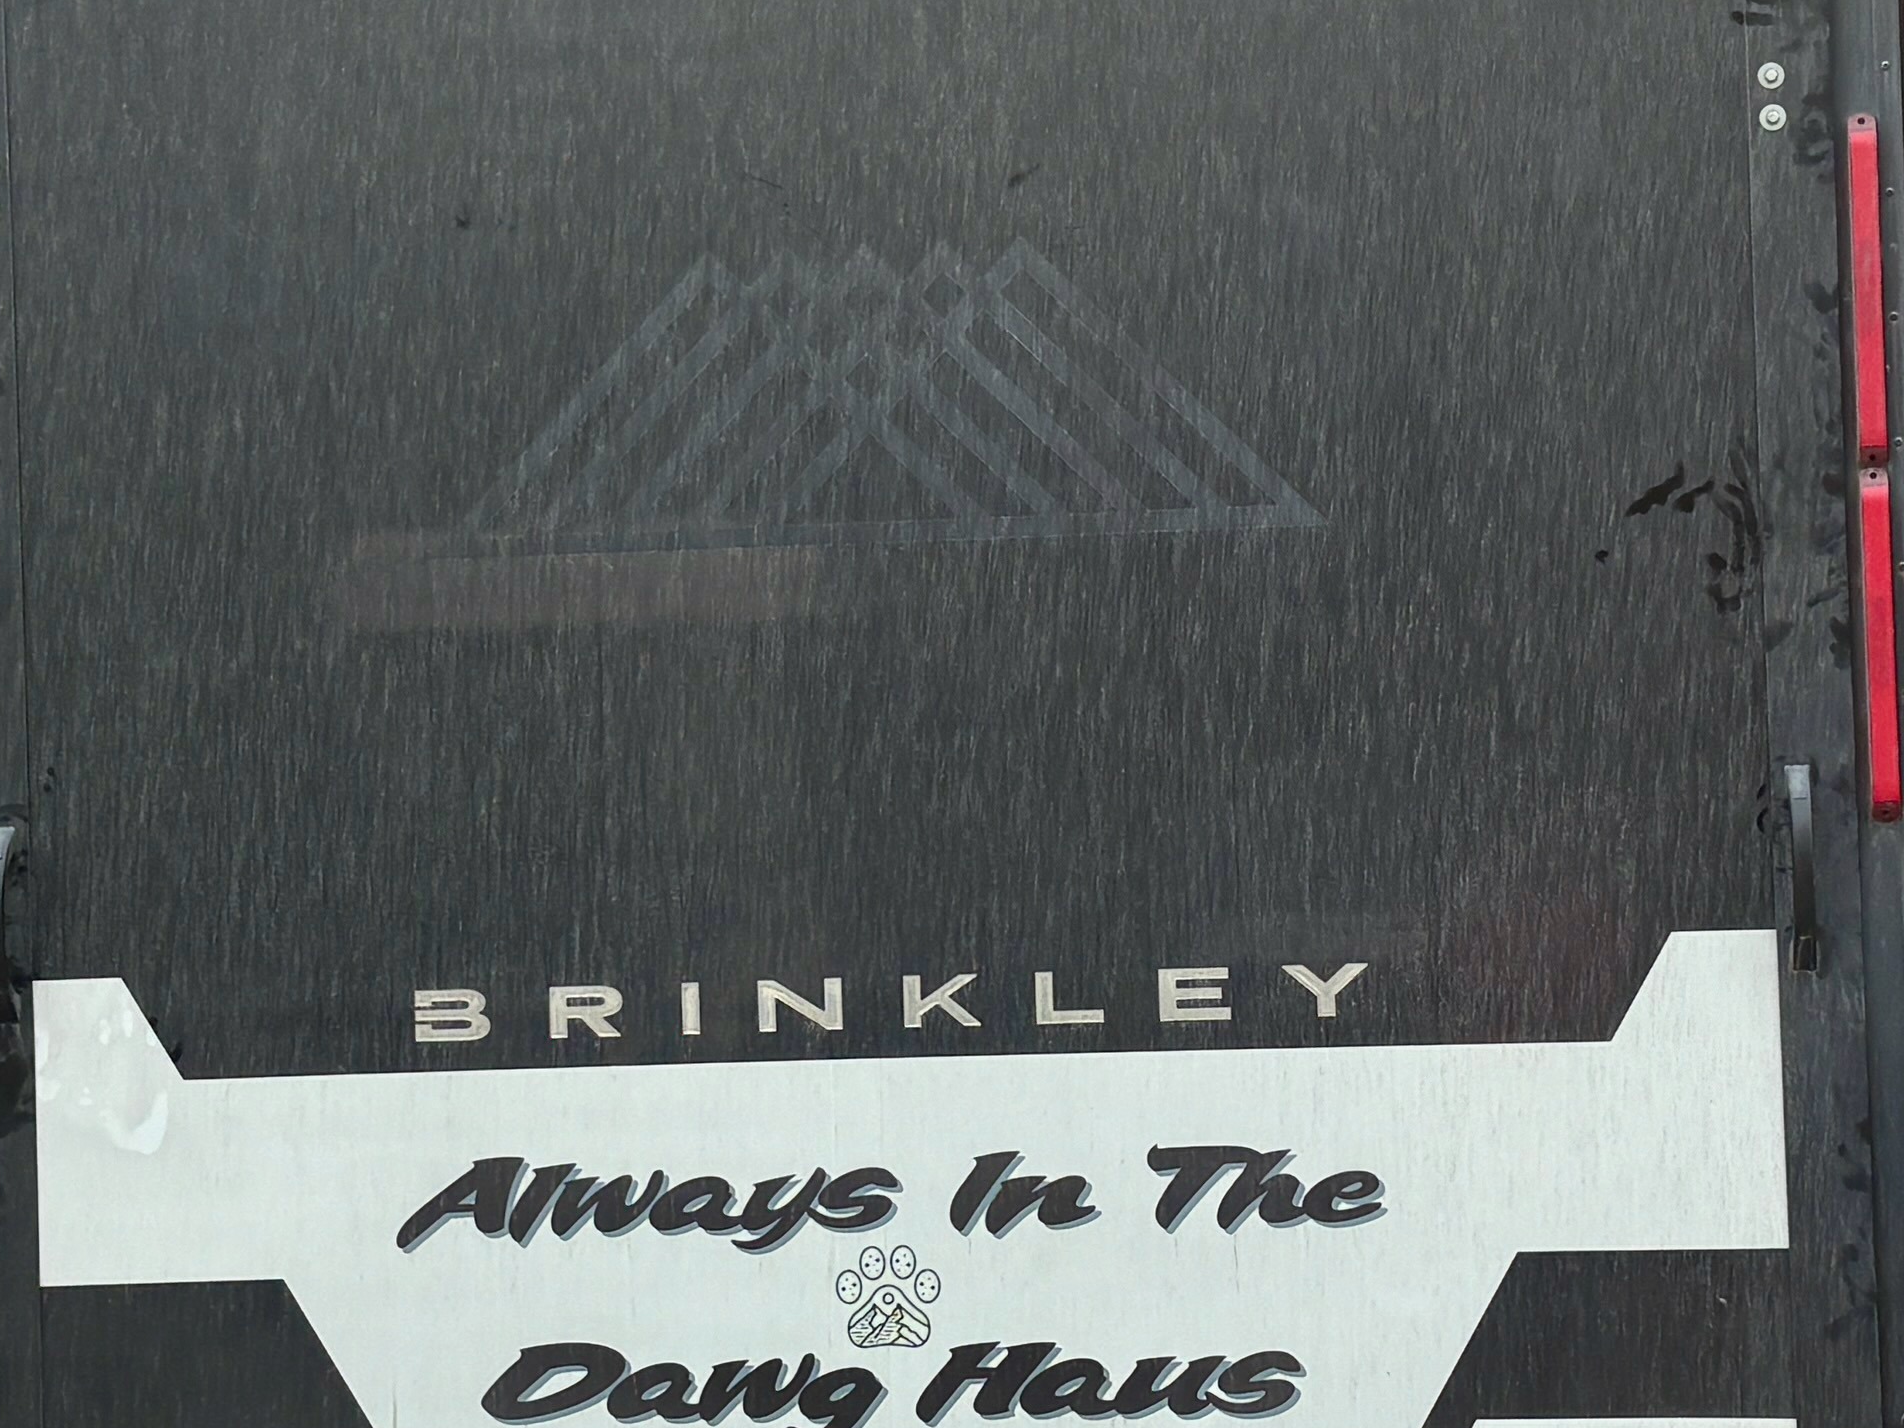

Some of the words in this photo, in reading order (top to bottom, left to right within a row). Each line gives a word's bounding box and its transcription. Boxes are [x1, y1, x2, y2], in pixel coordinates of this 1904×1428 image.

[413, 961, 1368, 1042] BRINKLEY
[396, 1155, 900, 1256] Always
[947, 1149, 1102, 1239] In
[1147, 1142, 1387, 1236] The
[915, 1339, 1306, 1428] Haus
